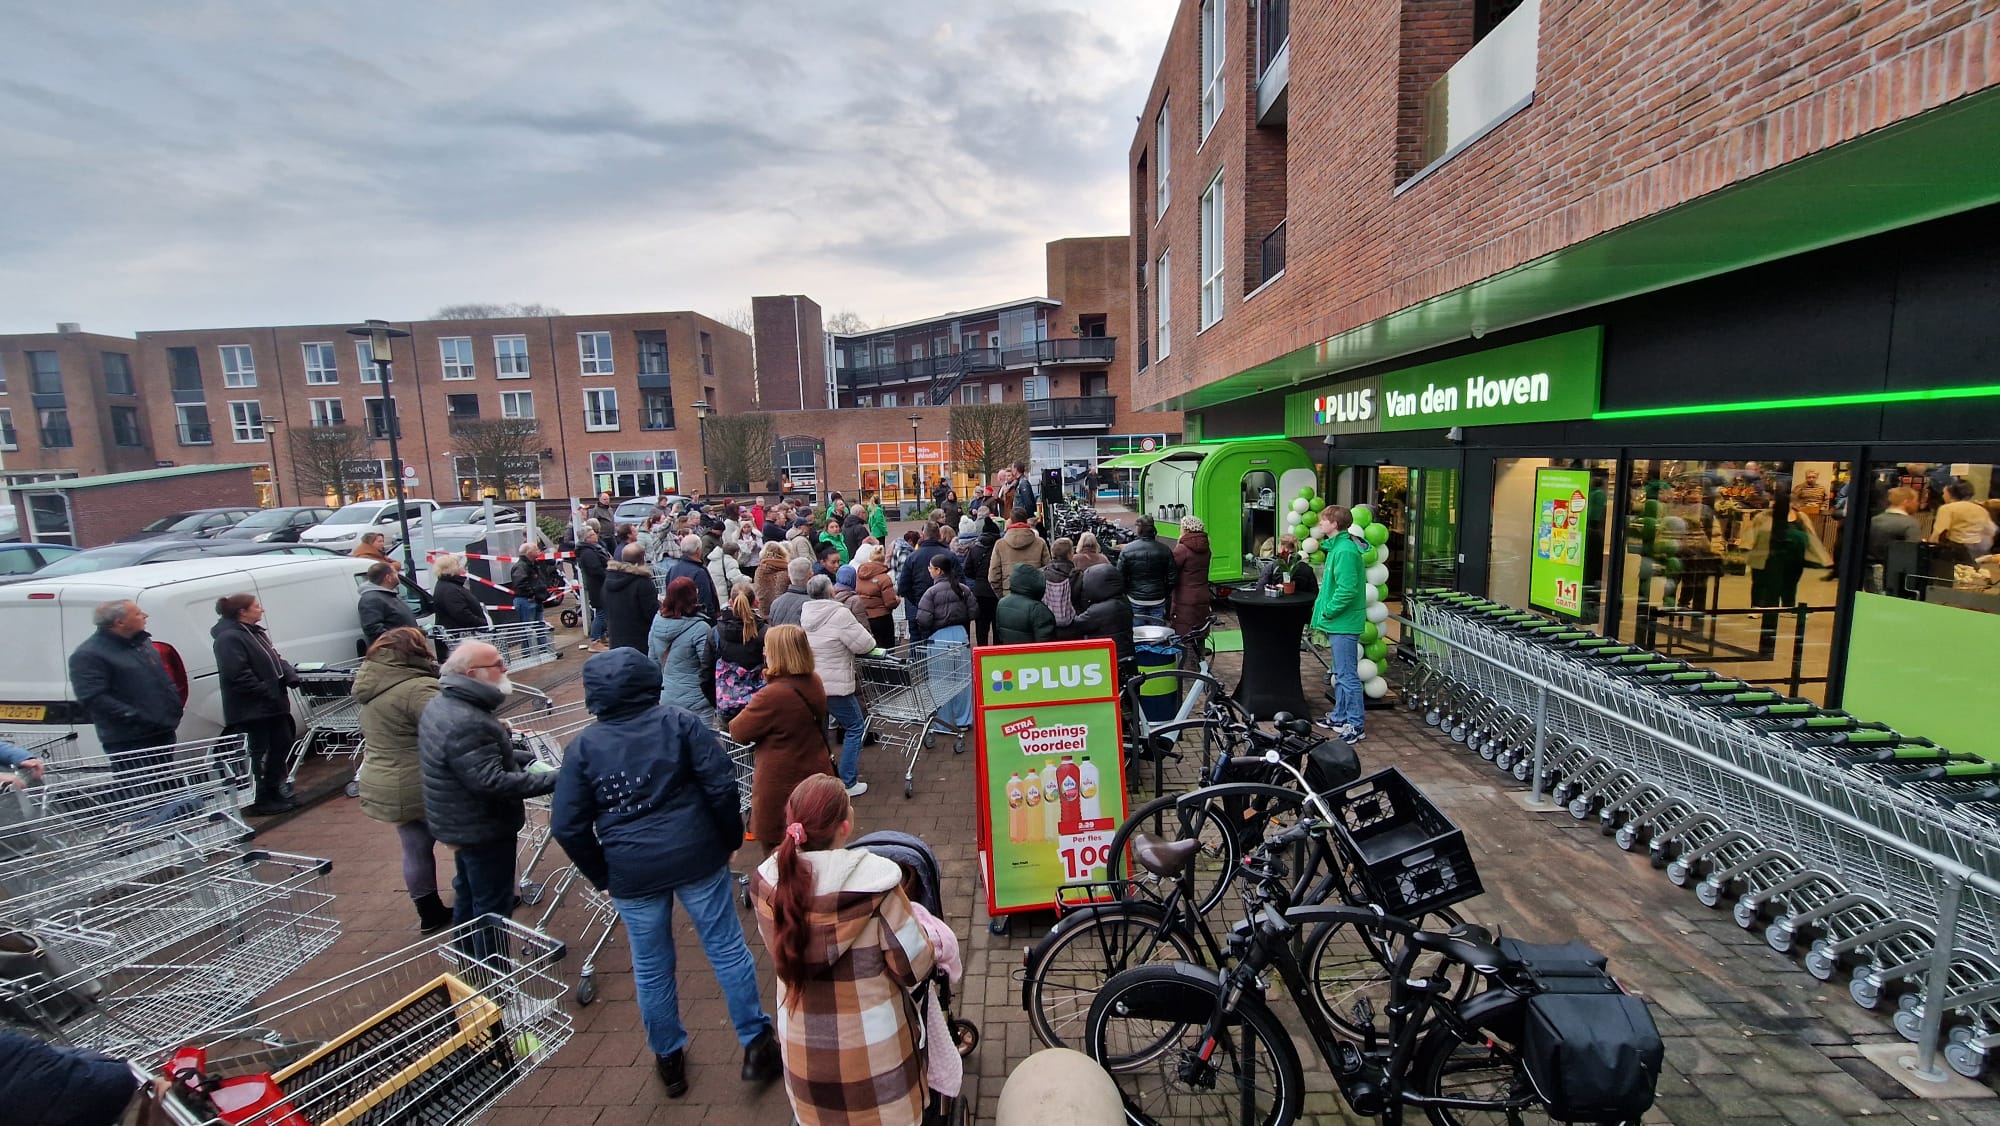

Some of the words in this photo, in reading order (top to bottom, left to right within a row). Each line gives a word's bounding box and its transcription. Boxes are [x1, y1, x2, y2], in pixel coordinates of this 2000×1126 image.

[1325, 388, 1373, 424] PLUS
[1386, 390, 1416, 419] Van
[1421, 383, 1457, 414] den
[1466, 372, 1549, 409] Hoven
[1556, 580, 1577, 601] 1+1
[1555, 598, 1577, 609] GRATIS
[1018, 663, 1103, 691] PLUS
[1004, 719, 1034, 734] EXTRA
[1020, 726, 1086, 741] Openings
[1023, 738, 1084, 753] voordeel
[1087, 834, 1102, 842] fles
[1061, 844, 1111, 879] 1.00
